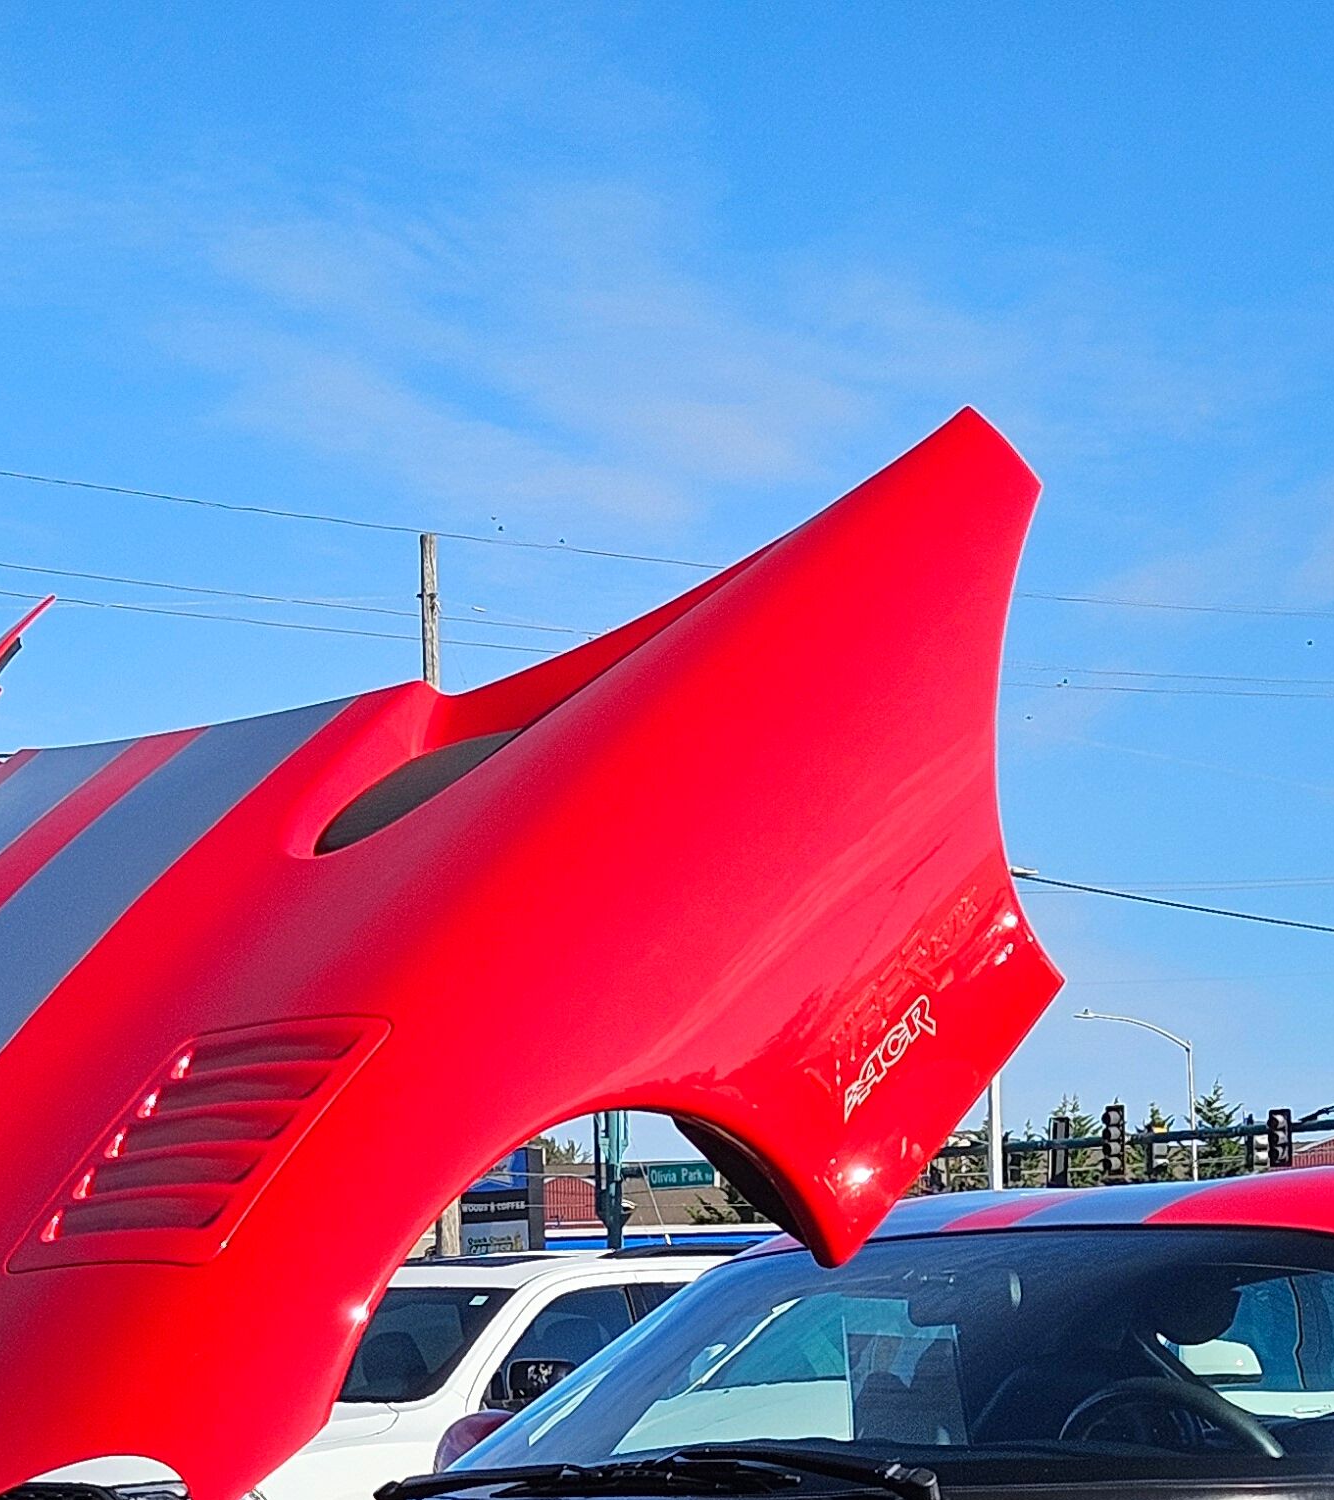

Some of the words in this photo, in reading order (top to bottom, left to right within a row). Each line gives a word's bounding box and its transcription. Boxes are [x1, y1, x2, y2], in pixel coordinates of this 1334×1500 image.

[845, 994, 936, 1123] ACR
[650, 1169, 677, 1184] Olivia
[681, 1167, 703, 1182] Park
[496, 1200, 526, 1211] COFFEE
